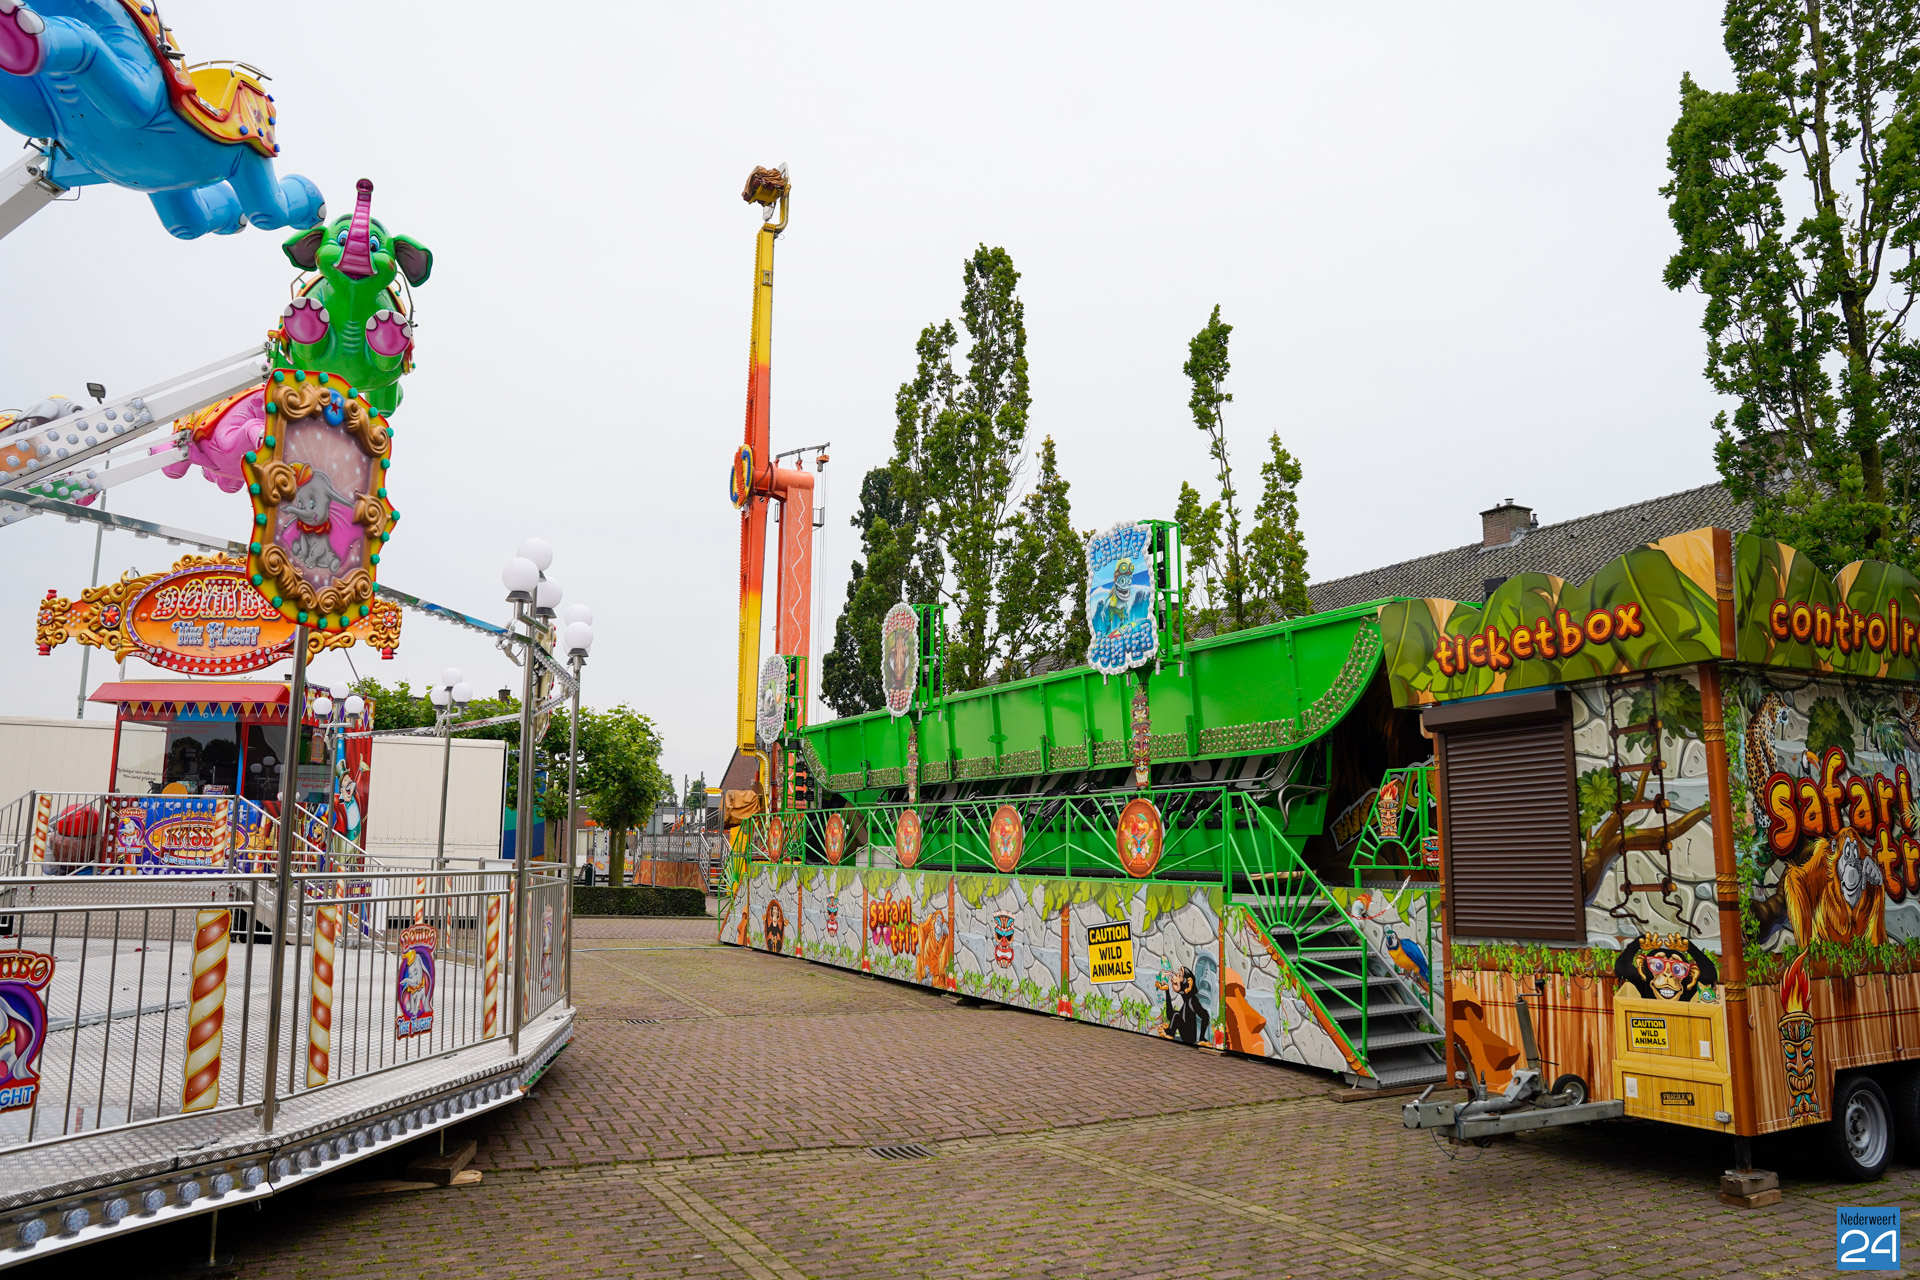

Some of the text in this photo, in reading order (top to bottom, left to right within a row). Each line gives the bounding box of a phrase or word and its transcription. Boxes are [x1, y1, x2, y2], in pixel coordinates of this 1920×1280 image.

[1769, 598, 1920, 657] controlr
[1434, 602, 1644, 676] ticketbox
[1765, 746, 1913, 856] safari
[164, 826, 214, 847] KASS
[869, 889, 912, 932] safari
[890, 921, 919, 956] trip
[1089, 925, 1129, 943] CAUTION
[1099, 946, 1122, 960] WILD
[1092, 961, 1132, 977] ANIMALS
[1632, 1019, 1664, 1028] CAUTION
[1635, 1037, 1666, 1045] ANIMALS
